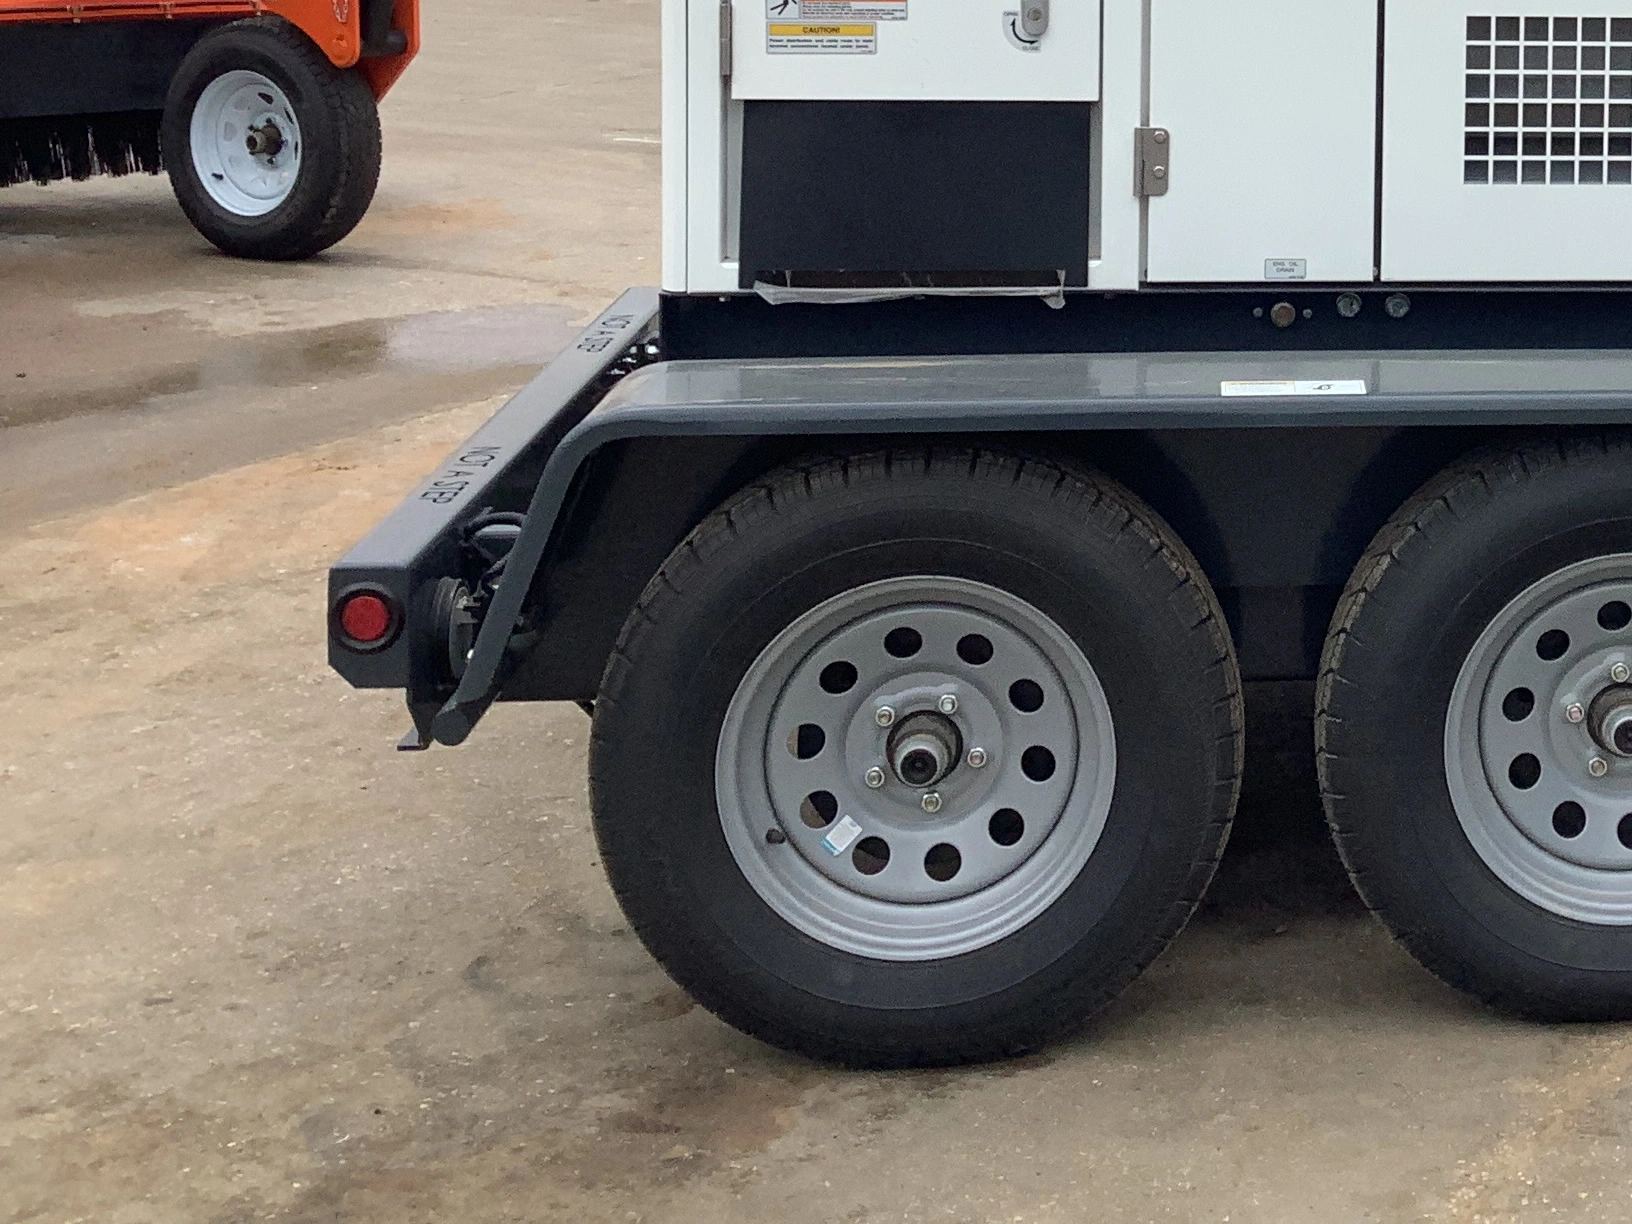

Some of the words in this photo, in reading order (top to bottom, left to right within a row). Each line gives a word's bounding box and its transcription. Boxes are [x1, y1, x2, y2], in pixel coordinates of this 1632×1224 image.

[599, 314, 635, 329] NOT
[577, 337, 614, 352] STEP
[453, 446, 502, 467] NOT
[418, 480, 470, 504] STEP
